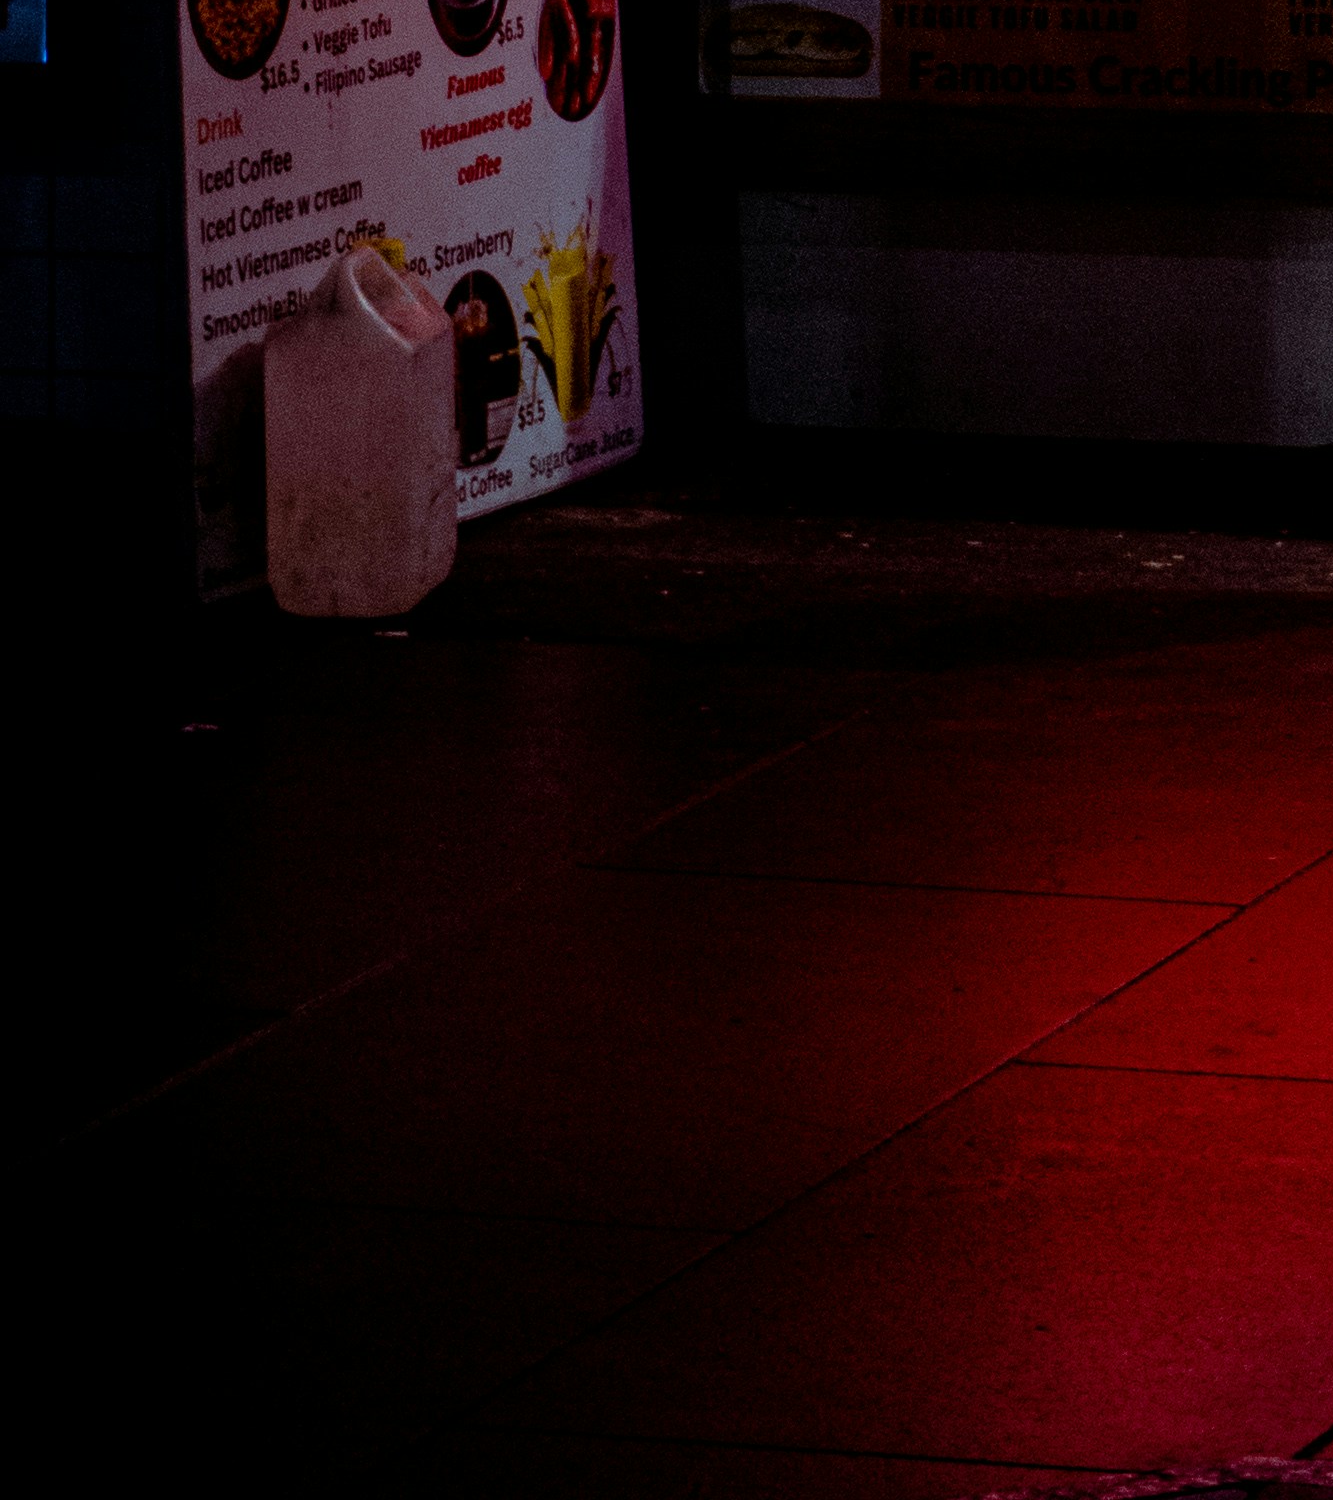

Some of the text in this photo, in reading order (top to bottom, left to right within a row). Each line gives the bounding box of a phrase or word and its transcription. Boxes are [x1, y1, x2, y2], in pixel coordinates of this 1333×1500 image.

[909, 52, 1075, 93] Famous
[1089, 57, 1292, 106] Crackling
[199, 148, 292, 194] Iced Coffee
